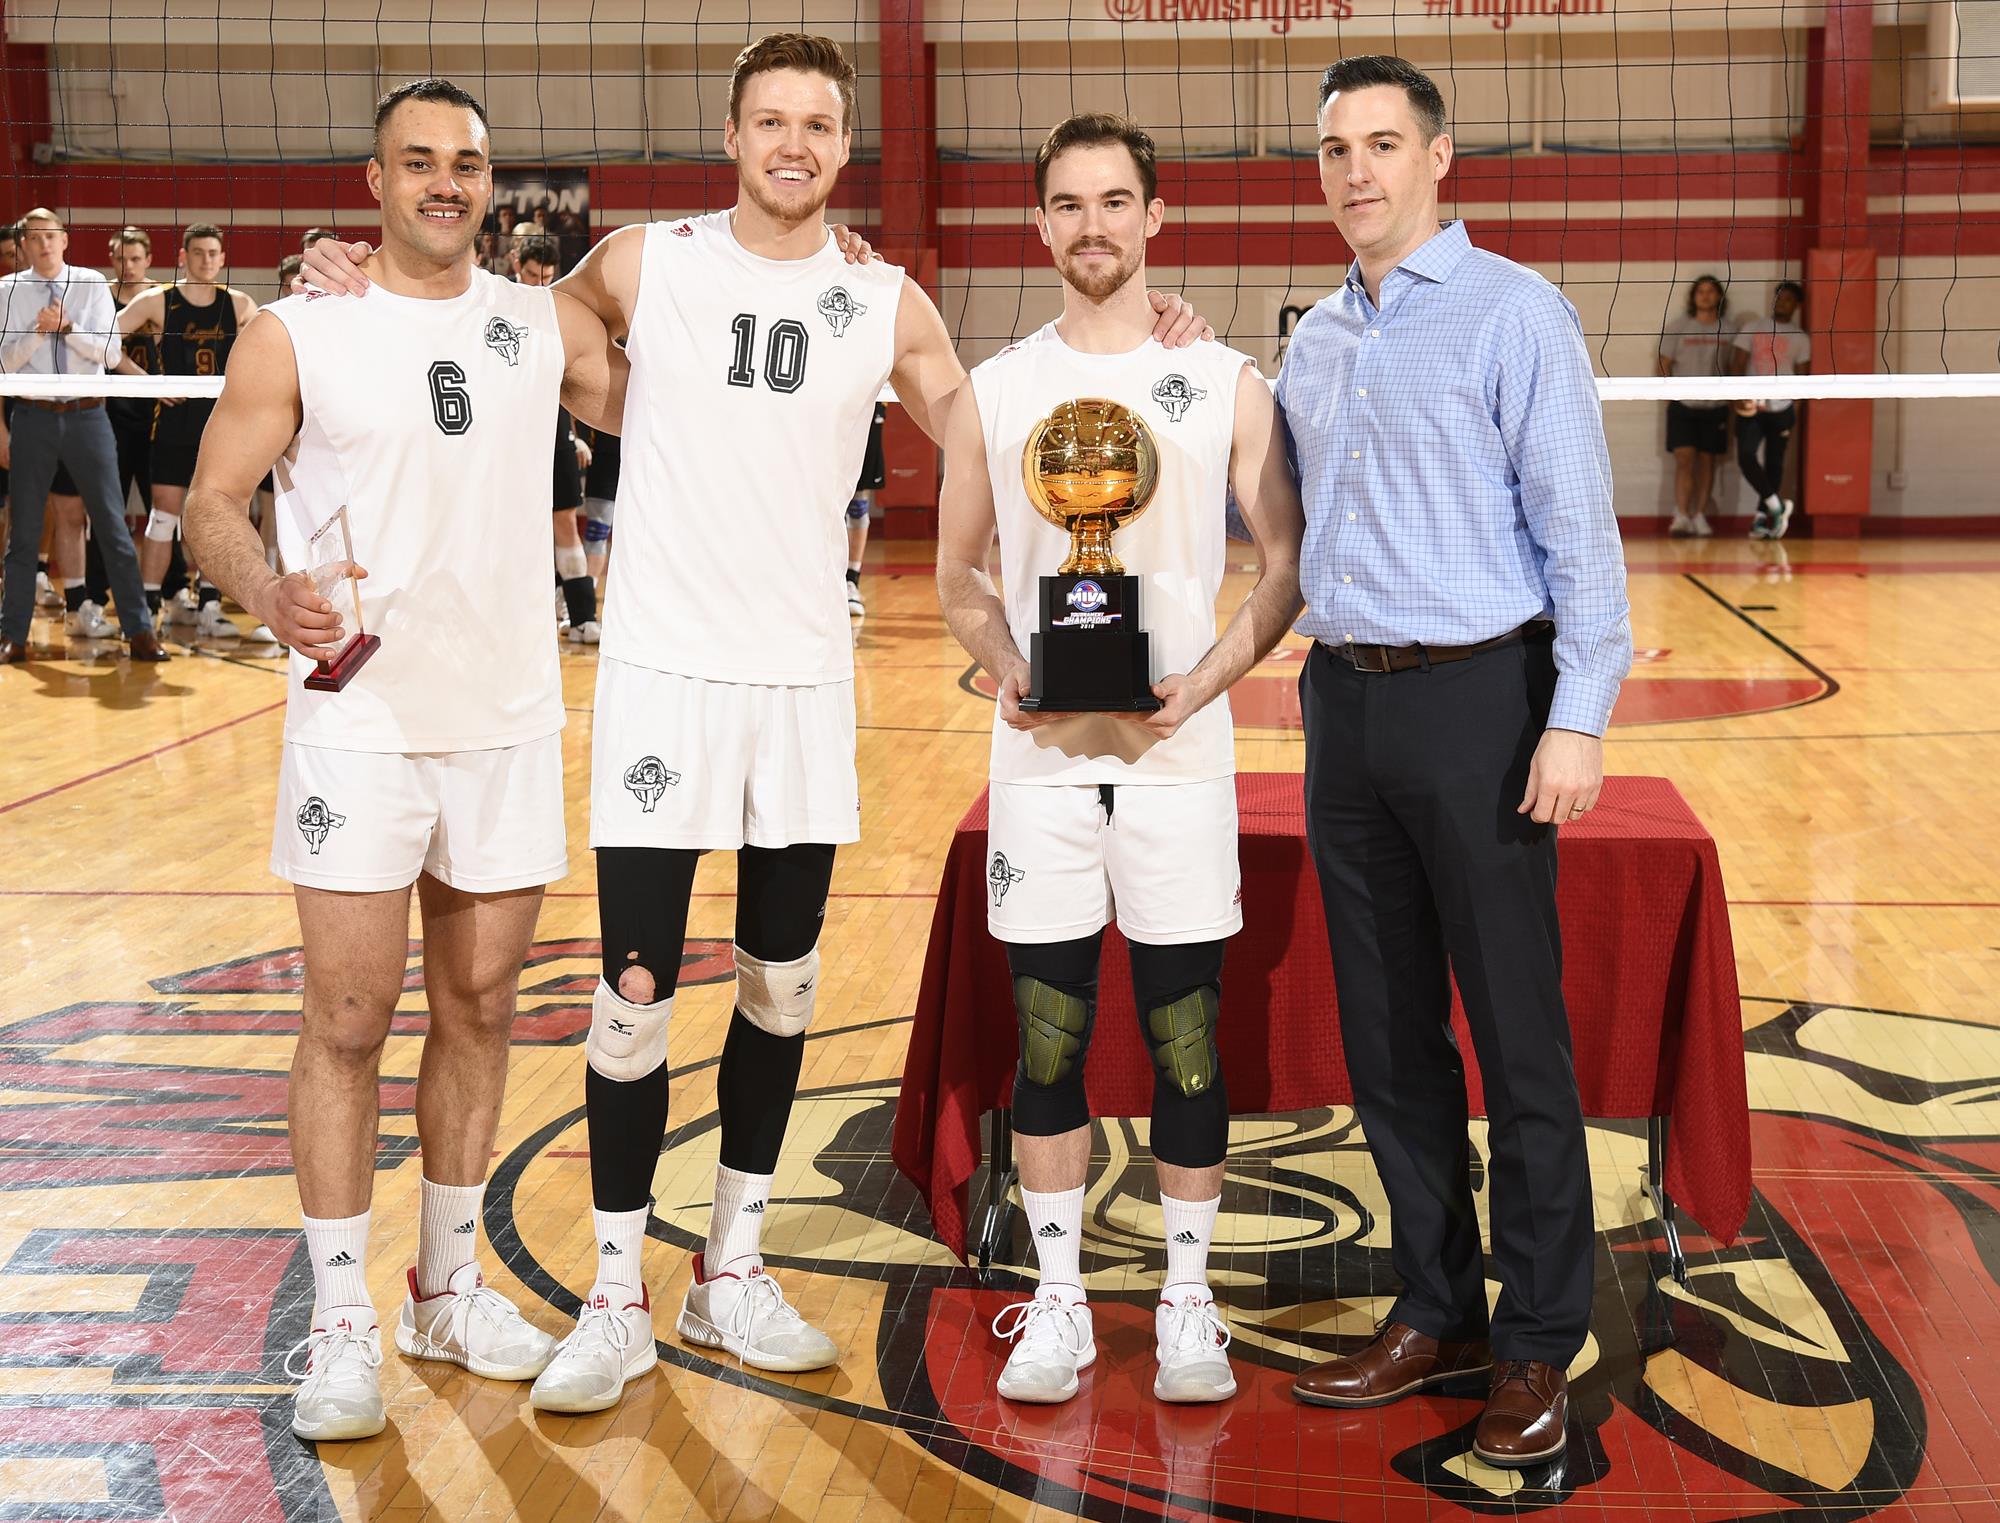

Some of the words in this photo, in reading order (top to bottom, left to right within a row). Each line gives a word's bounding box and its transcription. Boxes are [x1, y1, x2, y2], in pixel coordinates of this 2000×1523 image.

[728, 313, 809, 394] 10
[195, 348, 216, 375] 9
[427, 360, 473, 435] 6
[1067, 591, 1107, 605] MIVA
[1063, 616, 1112, 624] CHAMPIONS
[1037, 1230, 1067, 1238] adidas
[1172, 1234, 1200, 1245] adidas
[326, 1258, 357, 1267] adidas
